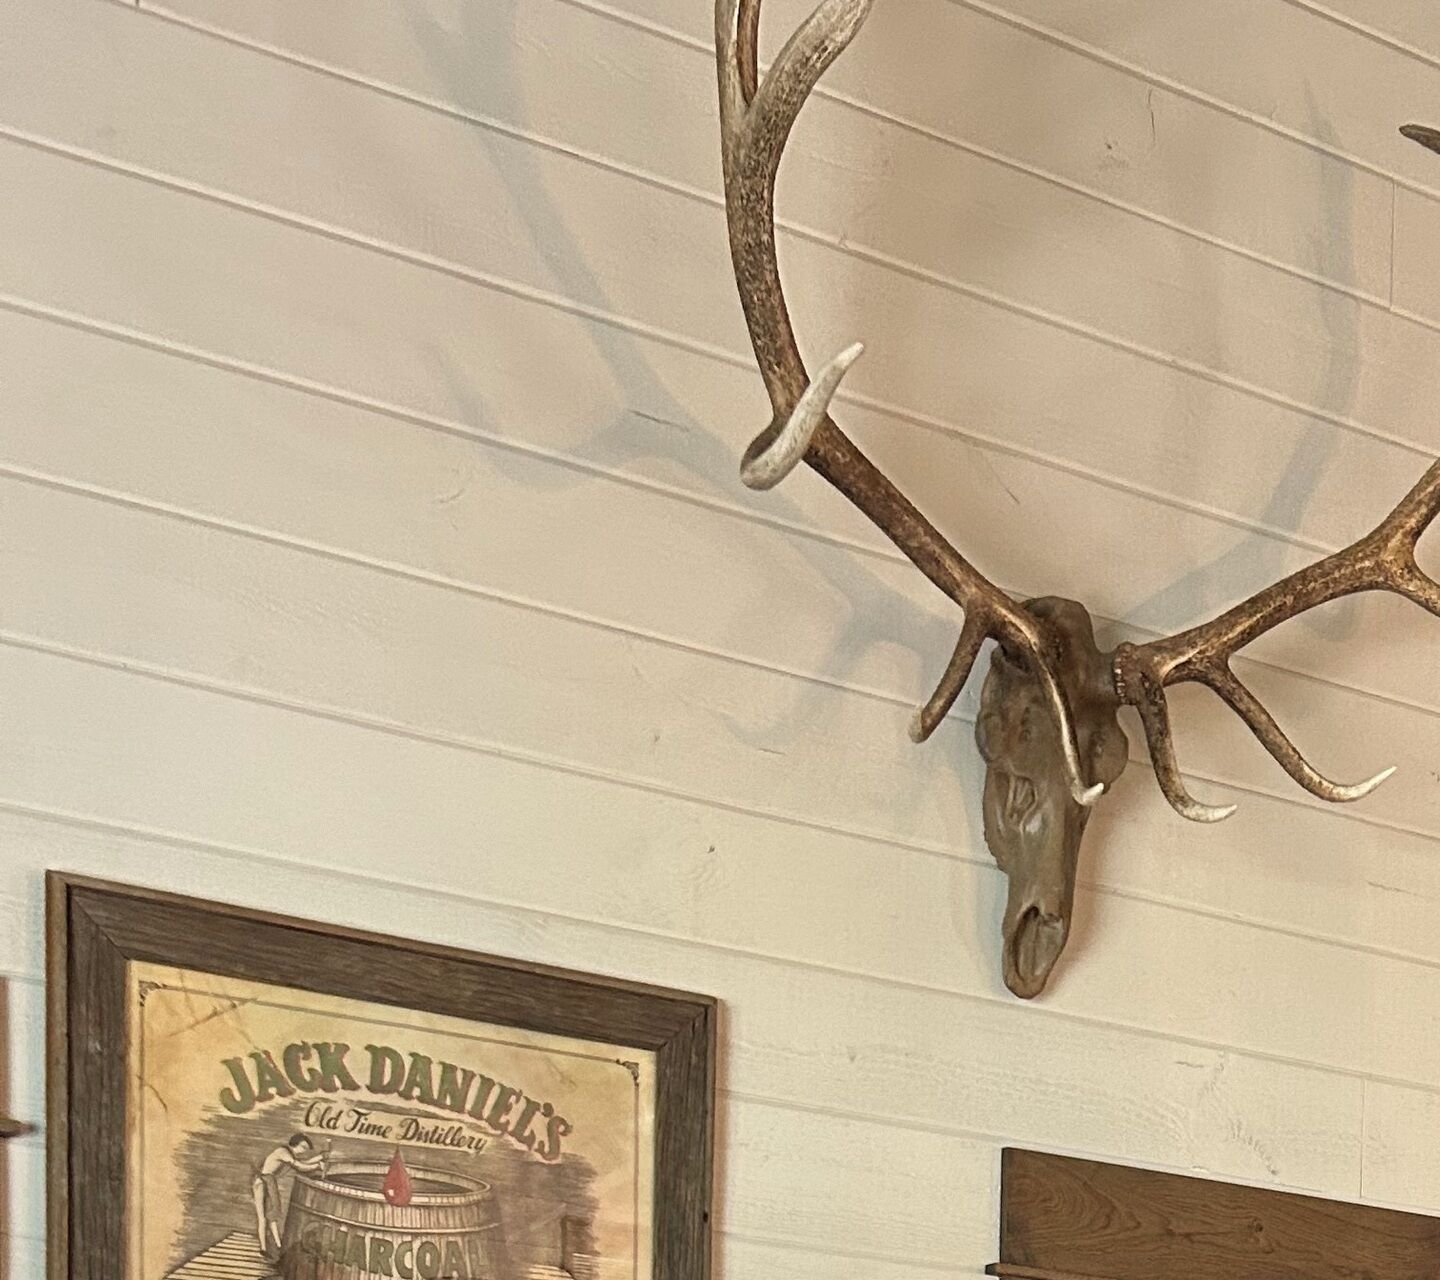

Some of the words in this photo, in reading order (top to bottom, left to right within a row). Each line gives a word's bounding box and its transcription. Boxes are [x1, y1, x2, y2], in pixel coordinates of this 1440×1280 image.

[219, 1041, 362, 1114] JACK
[365, 1044, 573, 1162] DANIEL'S
[304, 1101, 338, 1130] Old
[348, 1107, 393, 1140] Time
[396, 1116, 487, 1156] Distillery
[301, 1221, 490, 1280] CHARCOAL
